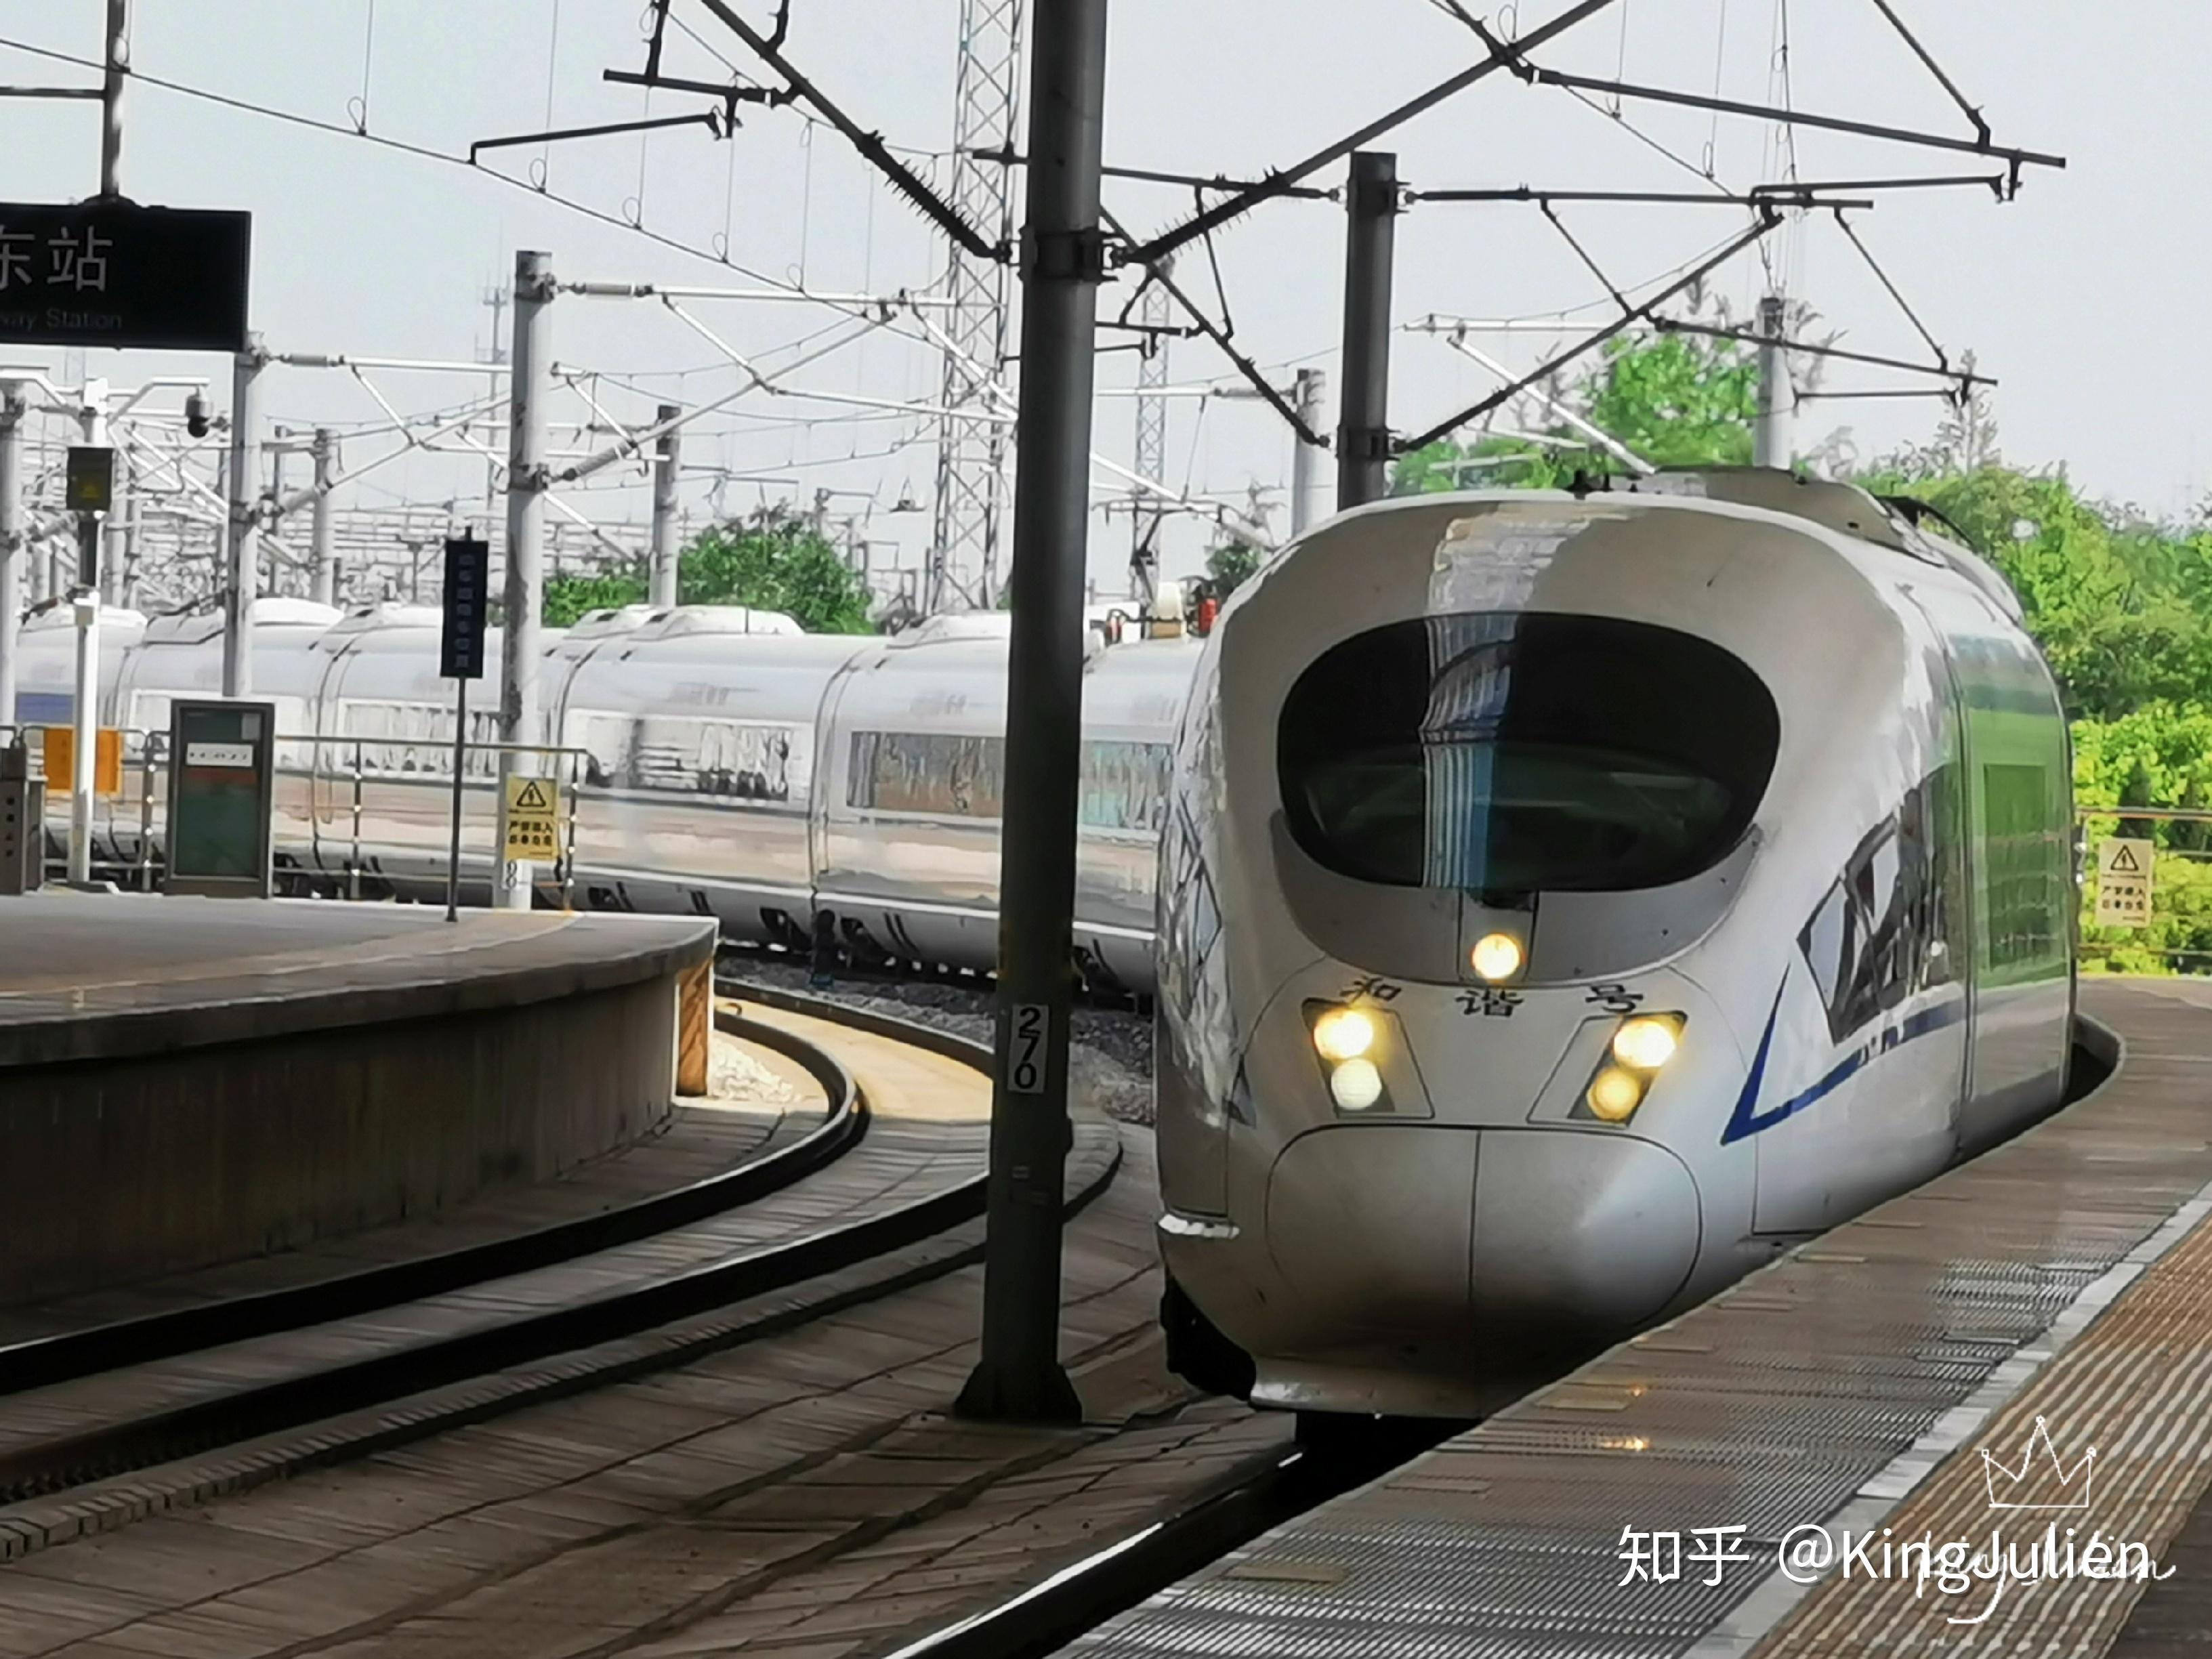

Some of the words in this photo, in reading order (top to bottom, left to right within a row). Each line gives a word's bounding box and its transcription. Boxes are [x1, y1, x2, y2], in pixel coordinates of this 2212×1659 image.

[0, 224, 113, 291] 东站
[46, 308, 123, 329] Station
[1014, 1007, 1041, 1089] 270
